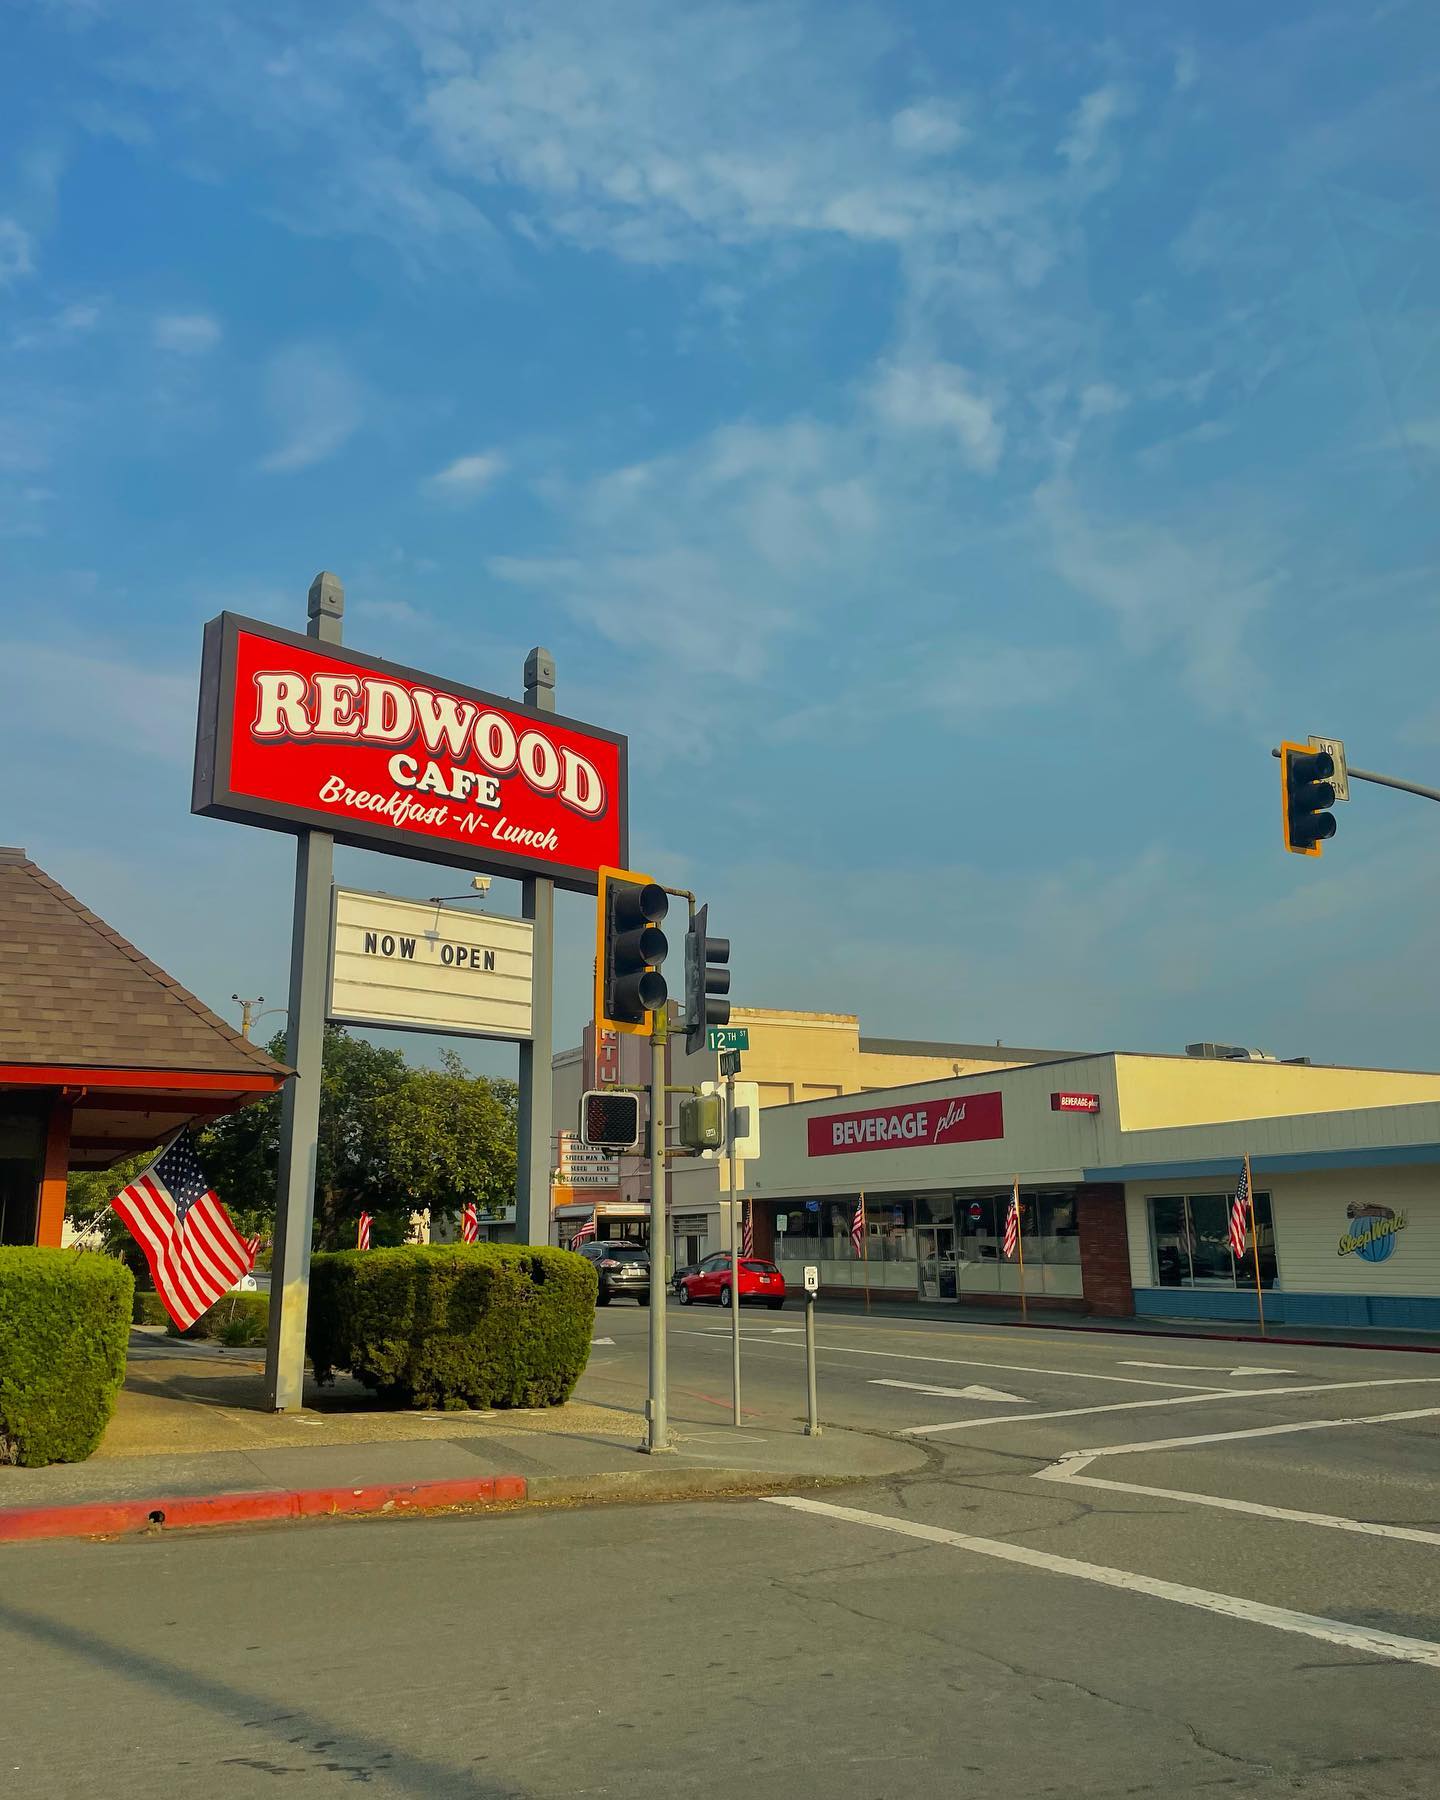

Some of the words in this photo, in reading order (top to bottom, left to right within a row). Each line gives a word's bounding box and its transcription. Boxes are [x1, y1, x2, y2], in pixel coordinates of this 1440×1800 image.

[251, 671, 606, 815] REDWOOD
[1320, 743, 1334, 756] NO
[387, 753, 501, 808] CAFE
[318, 775, 448, 827] Breakfast
[491, 817, 559, 851] Lunch
[364, 932, 416, 959] NOW
[440, 944, 495, 971] OPEN
[832, 1111, 928, 1146] BEVERAGE
[933, 1100, 967, 1143] plus
[1061, 1096, 1088, 1107] BEVERAGE
